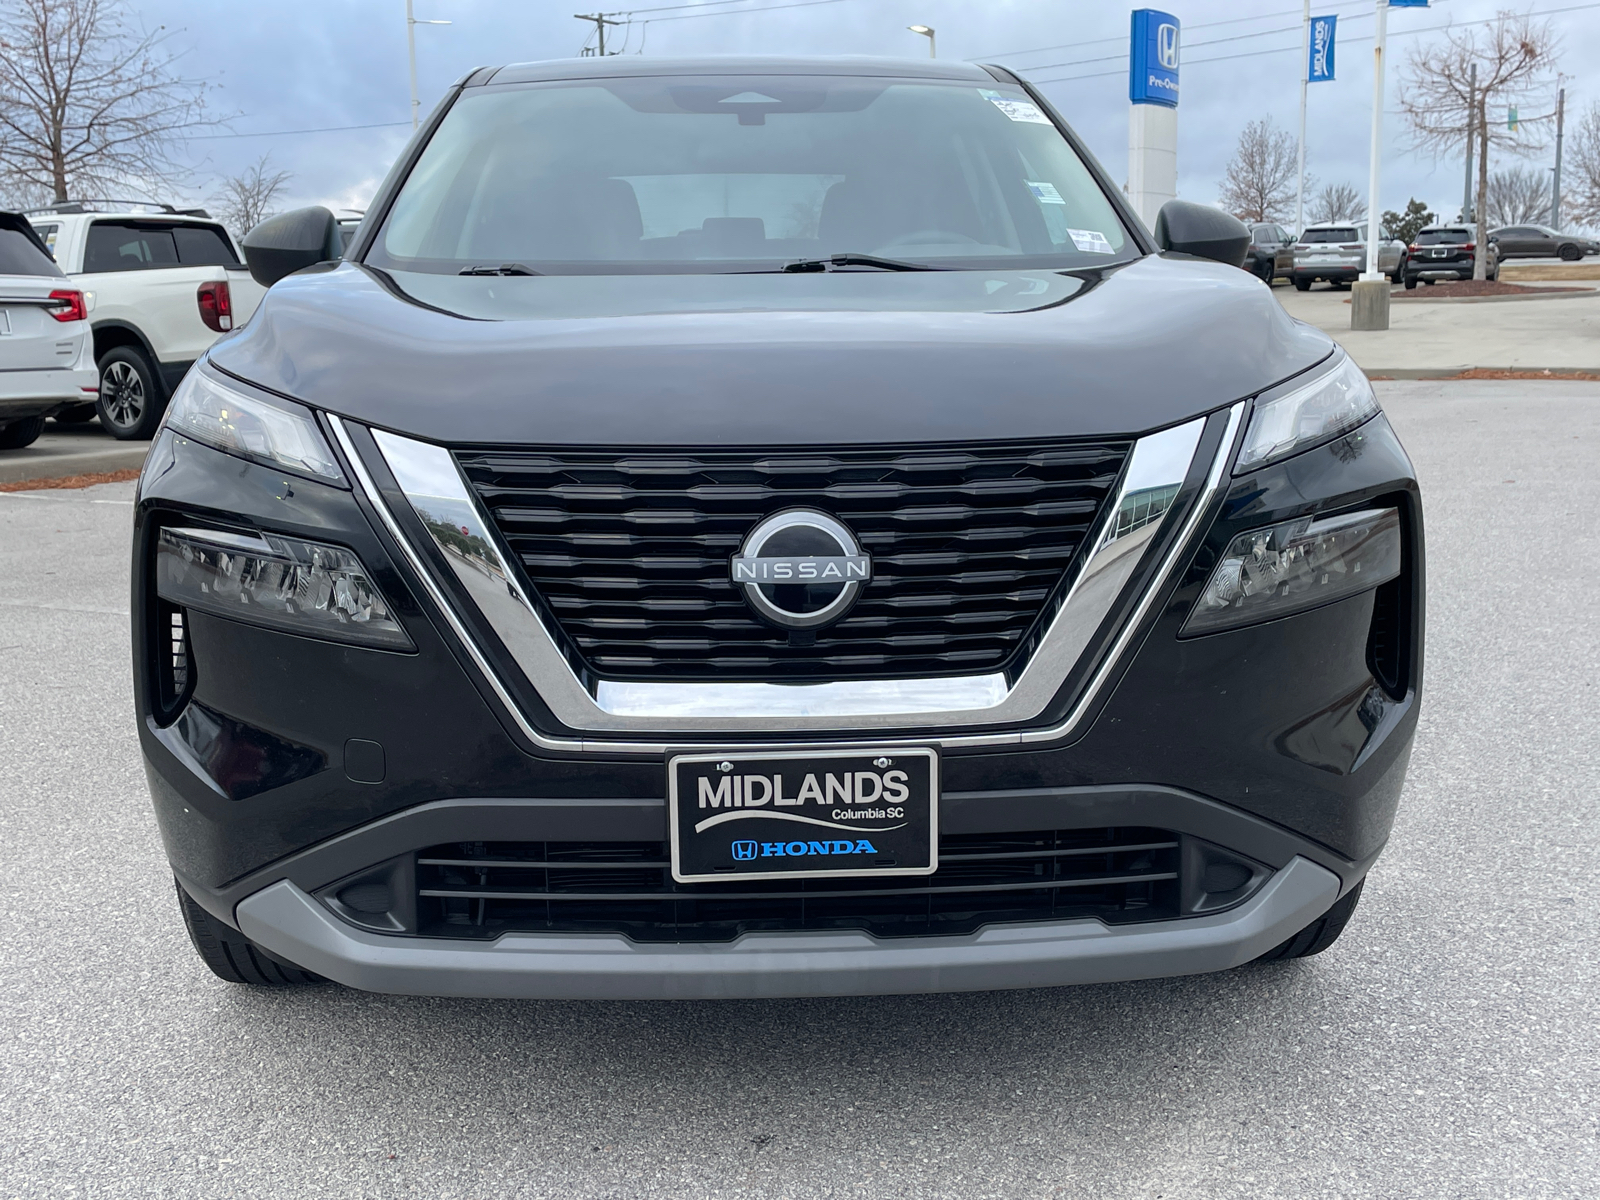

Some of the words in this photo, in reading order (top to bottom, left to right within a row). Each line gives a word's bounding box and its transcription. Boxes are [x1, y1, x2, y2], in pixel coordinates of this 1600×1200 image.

[1313, 20, 1325, 76] MIDLANDS
[737, 560, 866, 579] NISSAN
[697, 770, 910, 808] MIDLANDS
[831, 810, 886, 820] Columbia
[887, 808, 905, 819] SC
[760, 839, 878, 857] HONDA
